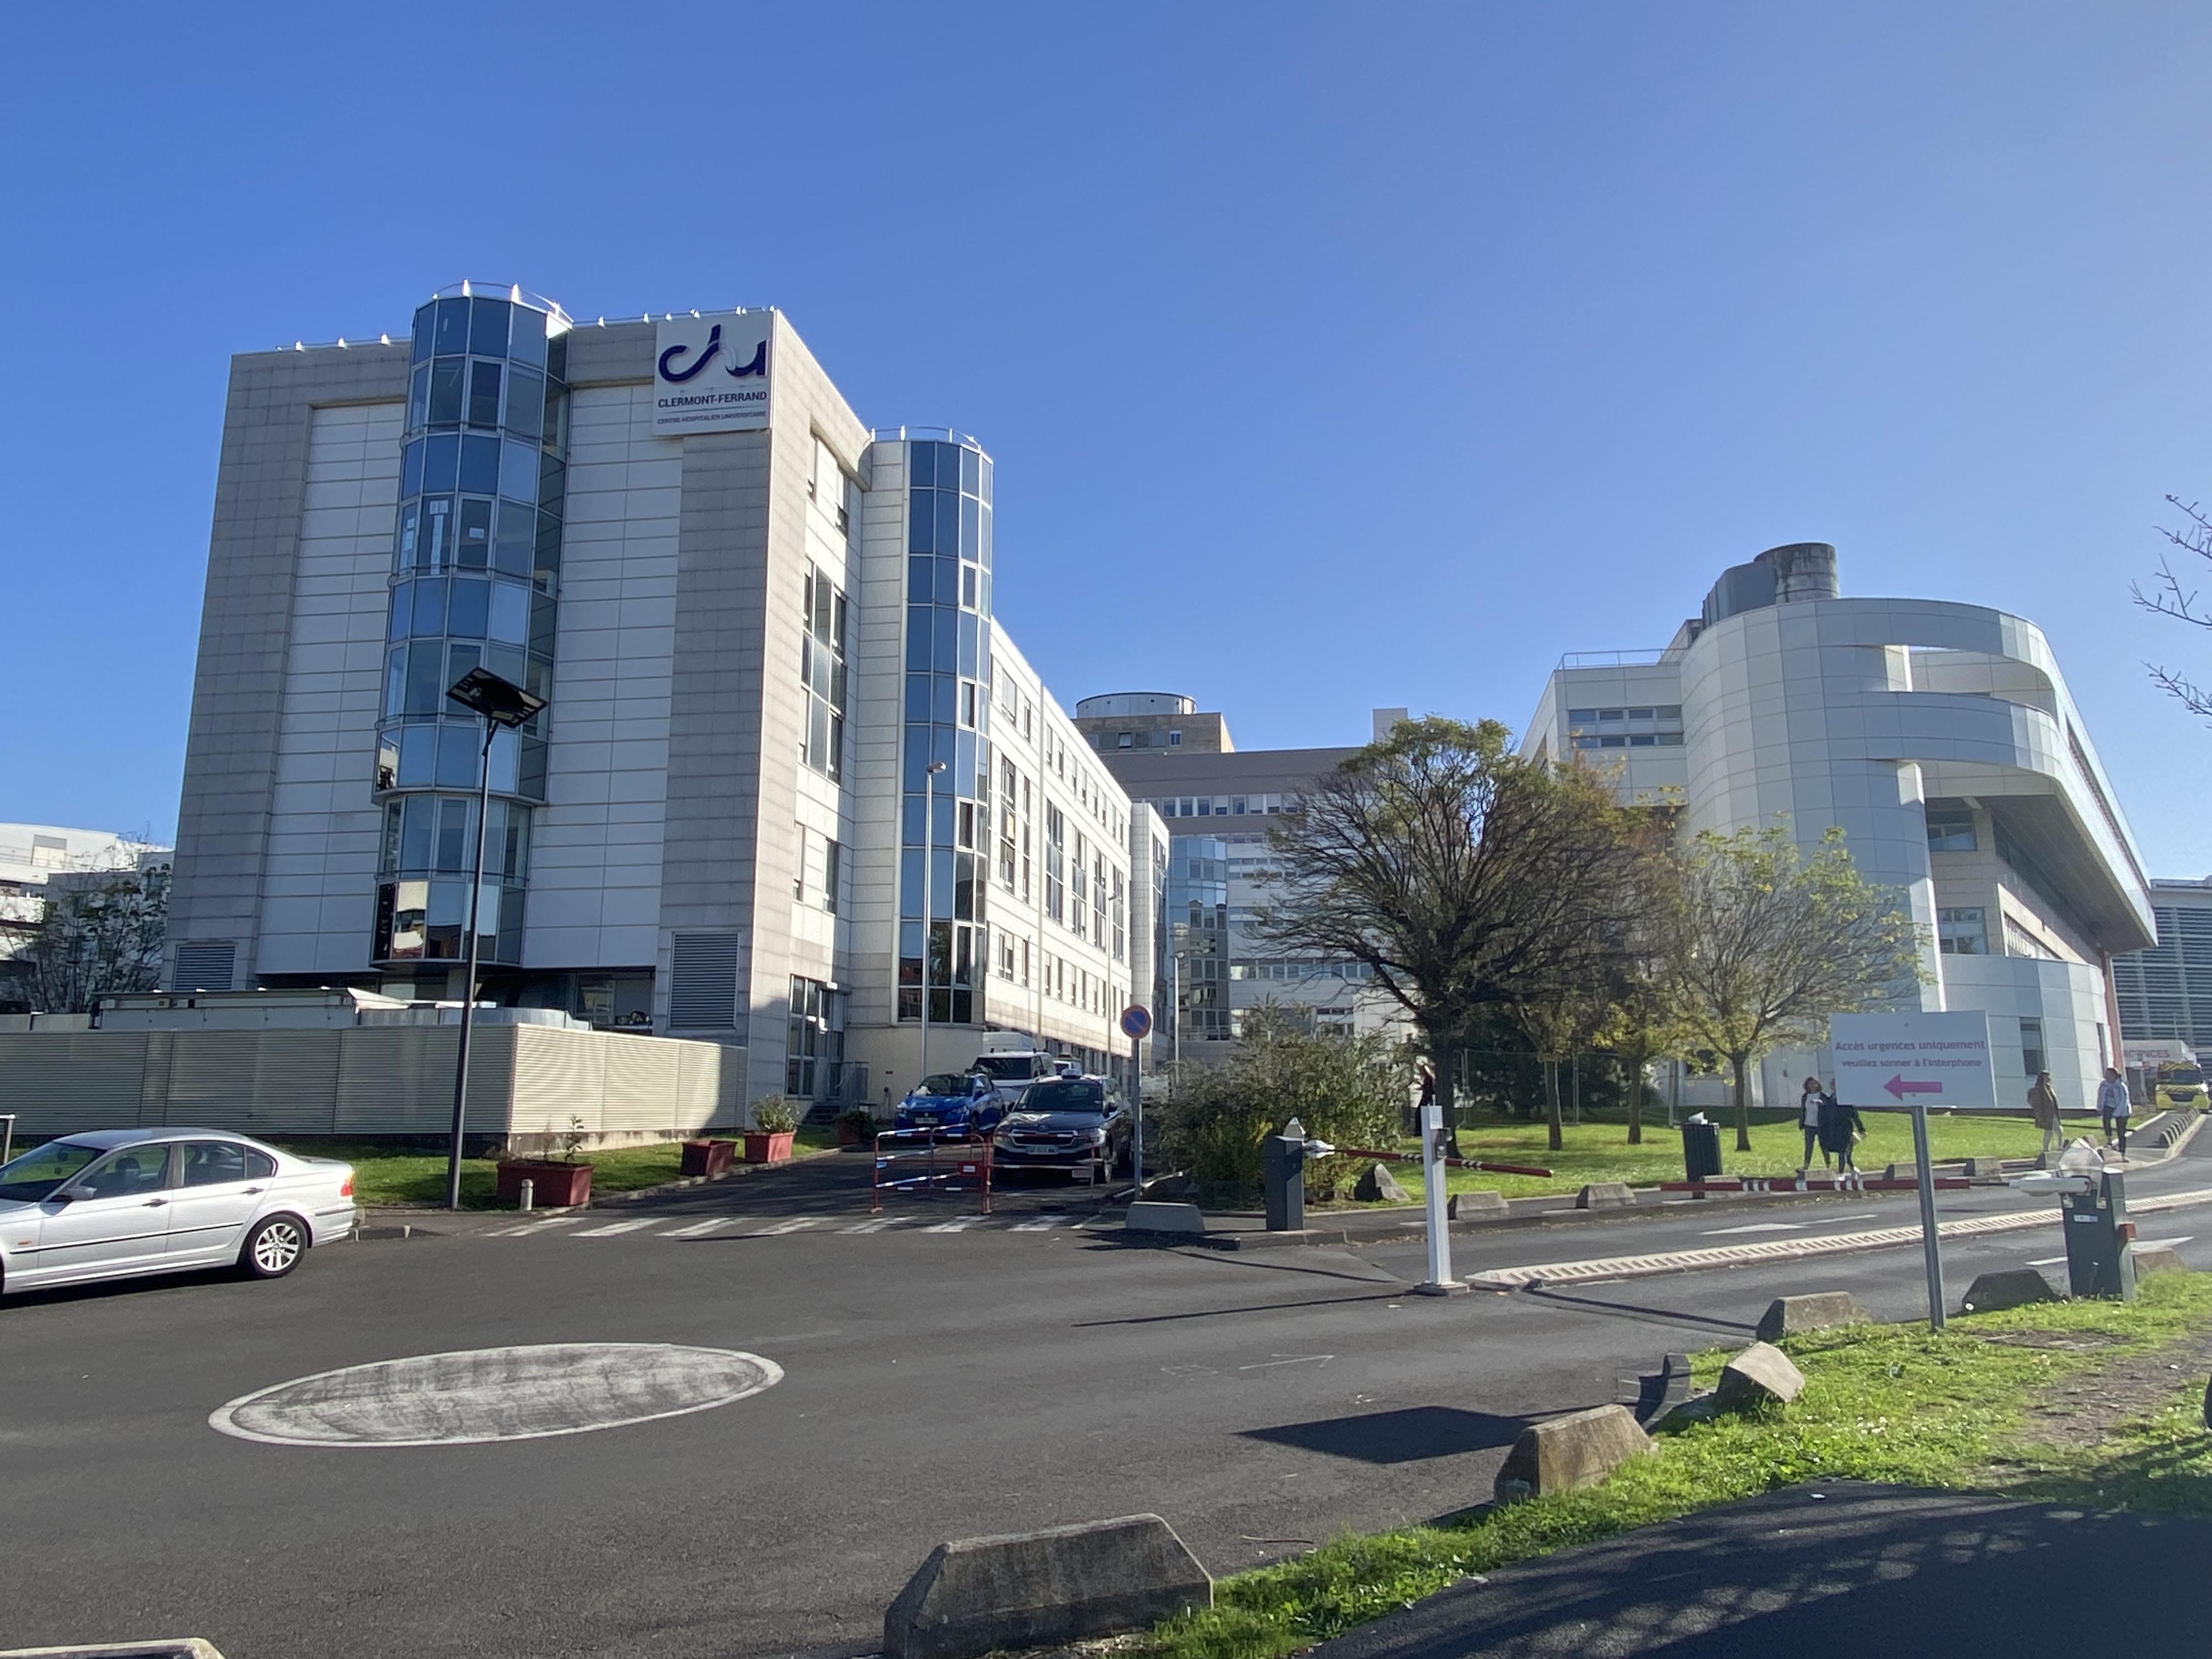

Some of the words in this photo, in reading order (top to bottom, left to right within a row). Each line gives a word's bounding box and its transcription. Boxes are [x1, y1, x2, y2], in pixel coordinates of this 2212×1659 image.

[658, 391, 767, 408] CLERMONT-FERRAND
[681, 414, 720, 422] HOSPITALIER
[721, 411, 766, 420] UNIVERSITAIRE
[1835, 1041, 1864, 1051] Accès
[1867, 1042, 1915, 1052] urgences
[1918, 1040, 1985, 1051] uniquement
[1841, 1058, 1877, 1067] veuillez
[1915, 1058, 1920, 1066] à
[1922, 1058, 1982, 1068] l'interphone
